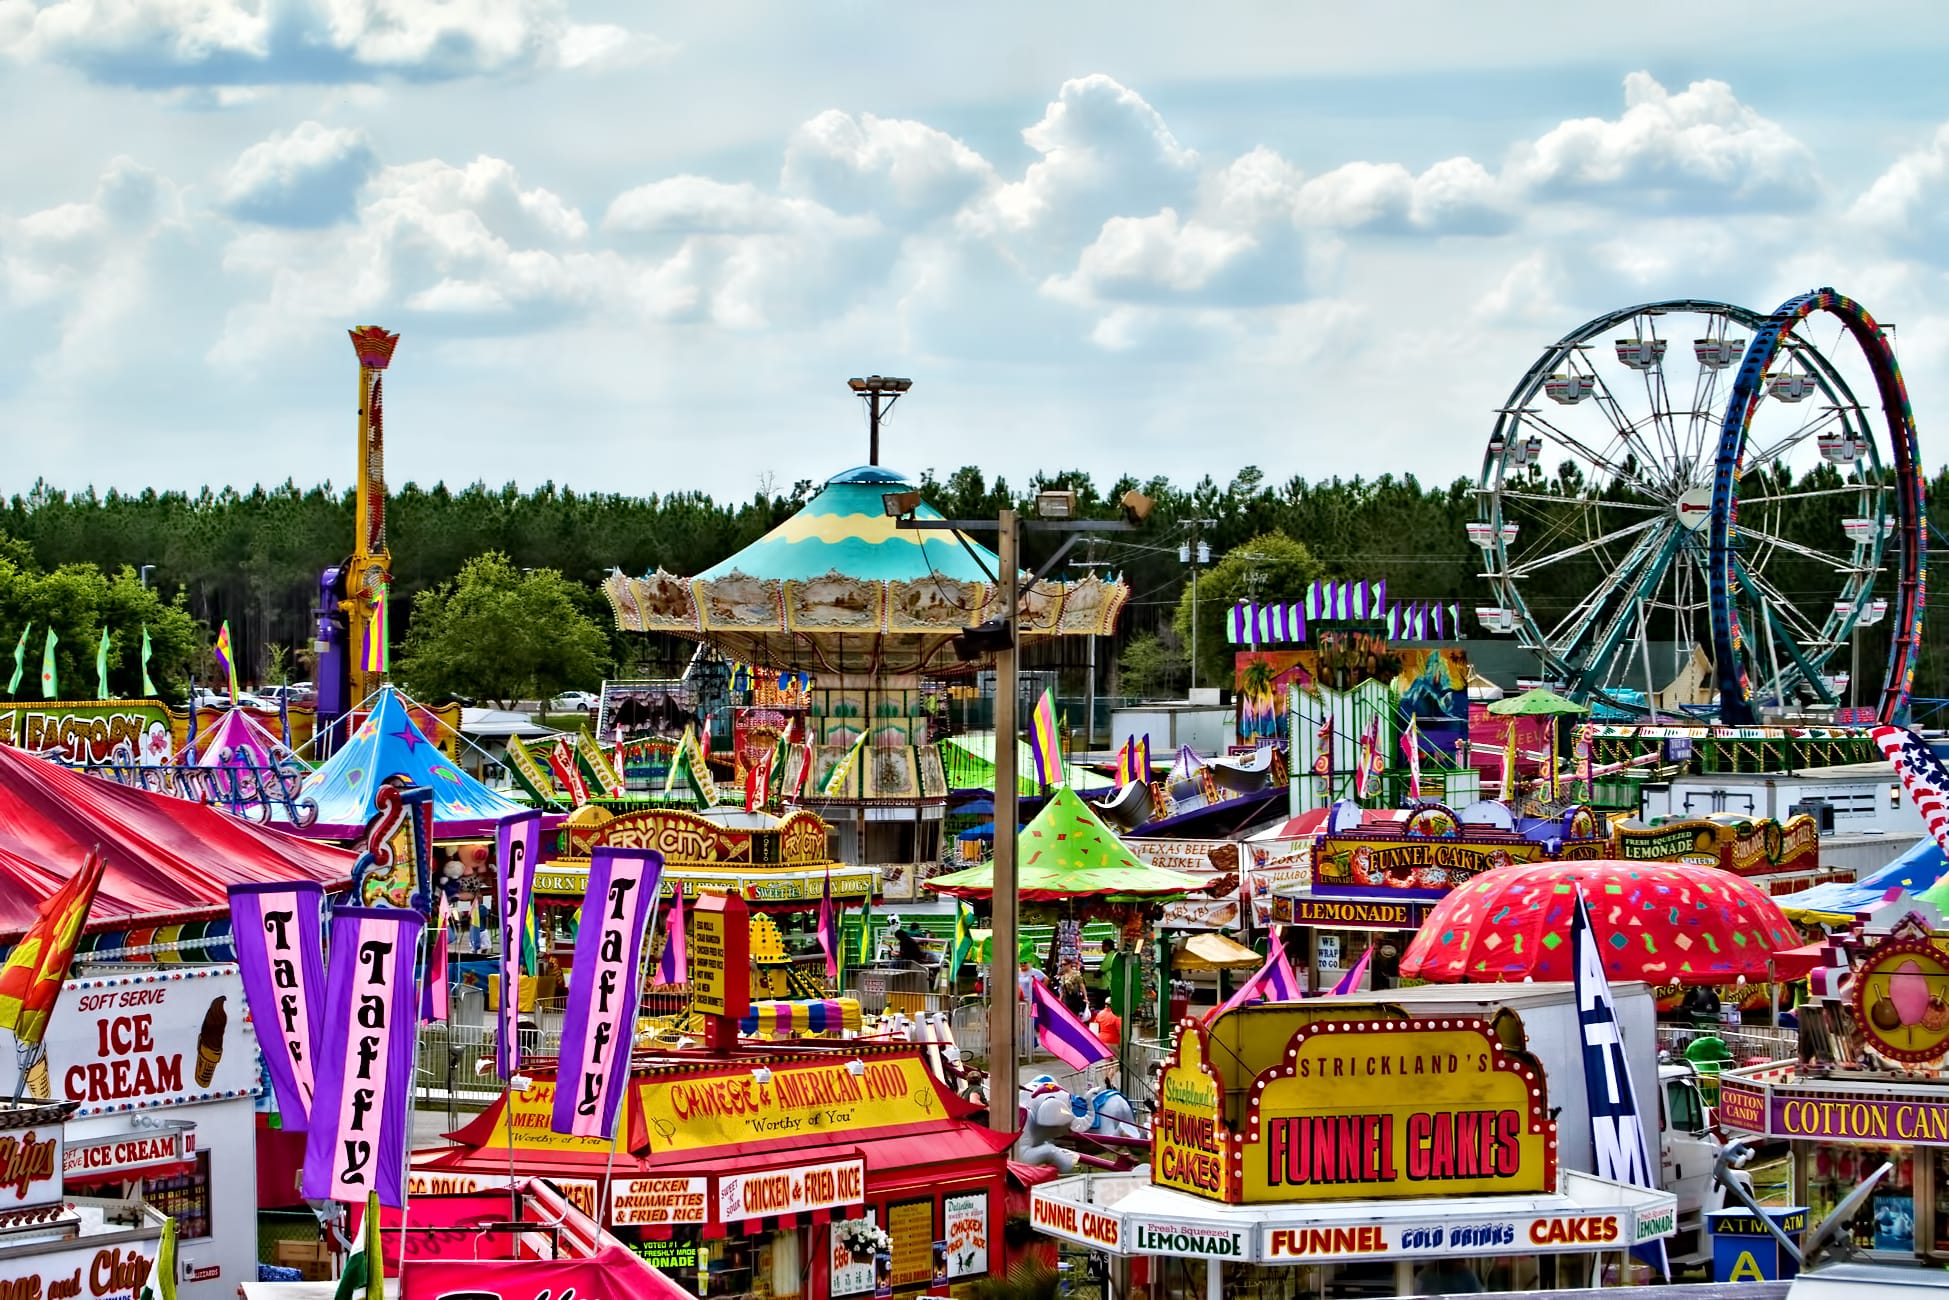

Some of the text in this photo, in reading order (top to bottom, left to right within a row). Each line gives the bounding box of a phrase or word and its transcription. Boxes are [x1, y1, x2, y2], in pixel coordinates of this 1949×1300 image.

[25, 712, 147, 765] FACTORY
[658, 829, 713, 858] CITY
[1141, 843, 1180, 854] TEXAS
[1625, 831, 1692, 846] FRESH SQUEEZED
[1369, 845, 1496, 873] FUNNEL CAKES
[1625, 839, 1693, 859] LEMONADE
[1151, 856, 1203, 868] BRISKET
[533, 874, 580, 891] CORN
[1272, 870, 1308, 883] JUMBO
[1320, 876, 1354, 884] LEMONADE
[755, 888, 787, 898] SWEET
[809, 881, 839, 895] CON
[841, 879, 870, 893] DOGS
[1300, 902, 1408, 923] LEMONADE
[1322, 937, 1335, 947] WE
[1318, 949, 1337, 958] WRAP
[1318, 960, 1338, 968] TO GO
[78, 988, 166, 1012] SOFT SERVE
[577, 877, 637, 1116] Taffy
[97, 1014, 153, 1057] ICE
[341, 941, 393, 1185] Taffy
[1300, 1053, 1488, 1078] STRICKLAND'S
[65, 1054, 183, 1101] CREAM
[670, 1063, 908, 1120] CHINESE & AMERICAN FOOD
[1166, 1076, 1215, 1108] Strickland's
[1722, 1090, 1764, 1110] COTTON
[505, 1112, 551, 1129] AMERI
[745, 1107, 855, 1133] "Worthy of You"
[1726, 1106, 1759, 1121] CANDY
[1783, 1100, 1889, 1137] COTTON
[561, 1135, 573, 1143] of
[1164, 1109, 1220, 1154] FUNNEL
[83, 1145, 111, 1168] ICE
[115, 1137, 175, 1165] CREAM
[1268, 1110, 1520, 1186] FUNNEL CAKES
[1162, 1145, 1221, 1192] CAKES
[630, 1180, 689, 1194] CHICKEN
[721, 1179, 738, 1199] SWEET
[743, 1166, 861, 1214] CHICKEN & FRIED RICE
[614, 1194, 704, 1208] DRUMMETTES
[726, 1199, 742, 1217] SOUR
[615, 1208, 704, 1223] & FRIED RICE
[1033, 1198, 1118, 1245] FUNNEL CAKES
[1636, 1208, 1673, 1240] LEMONADE
[1717, 1214, 1804, 1233] ATM ATM
[951, 1219, 984, 1238] CHICKEN
[1148, 1223, 1229, 1238] Fresh Squeezed
[1271, 1216, 1619, 1256] FUNNEL COLD DRINKS CAKES
[972, 1235, 986, 1249] RICE
[1138, 1225, 1242, 1256] LEMONADE
[644, 1249, 676, 1257] FRESHLY
[676, 1249, 697, 1257] MADE
[645, 1256, 696, 1268] ONADE
[48, 1267, 82, 1300] and
[89, 1248, 155, 1298] Chip
[1728, 1251, 1765, 1283] A
